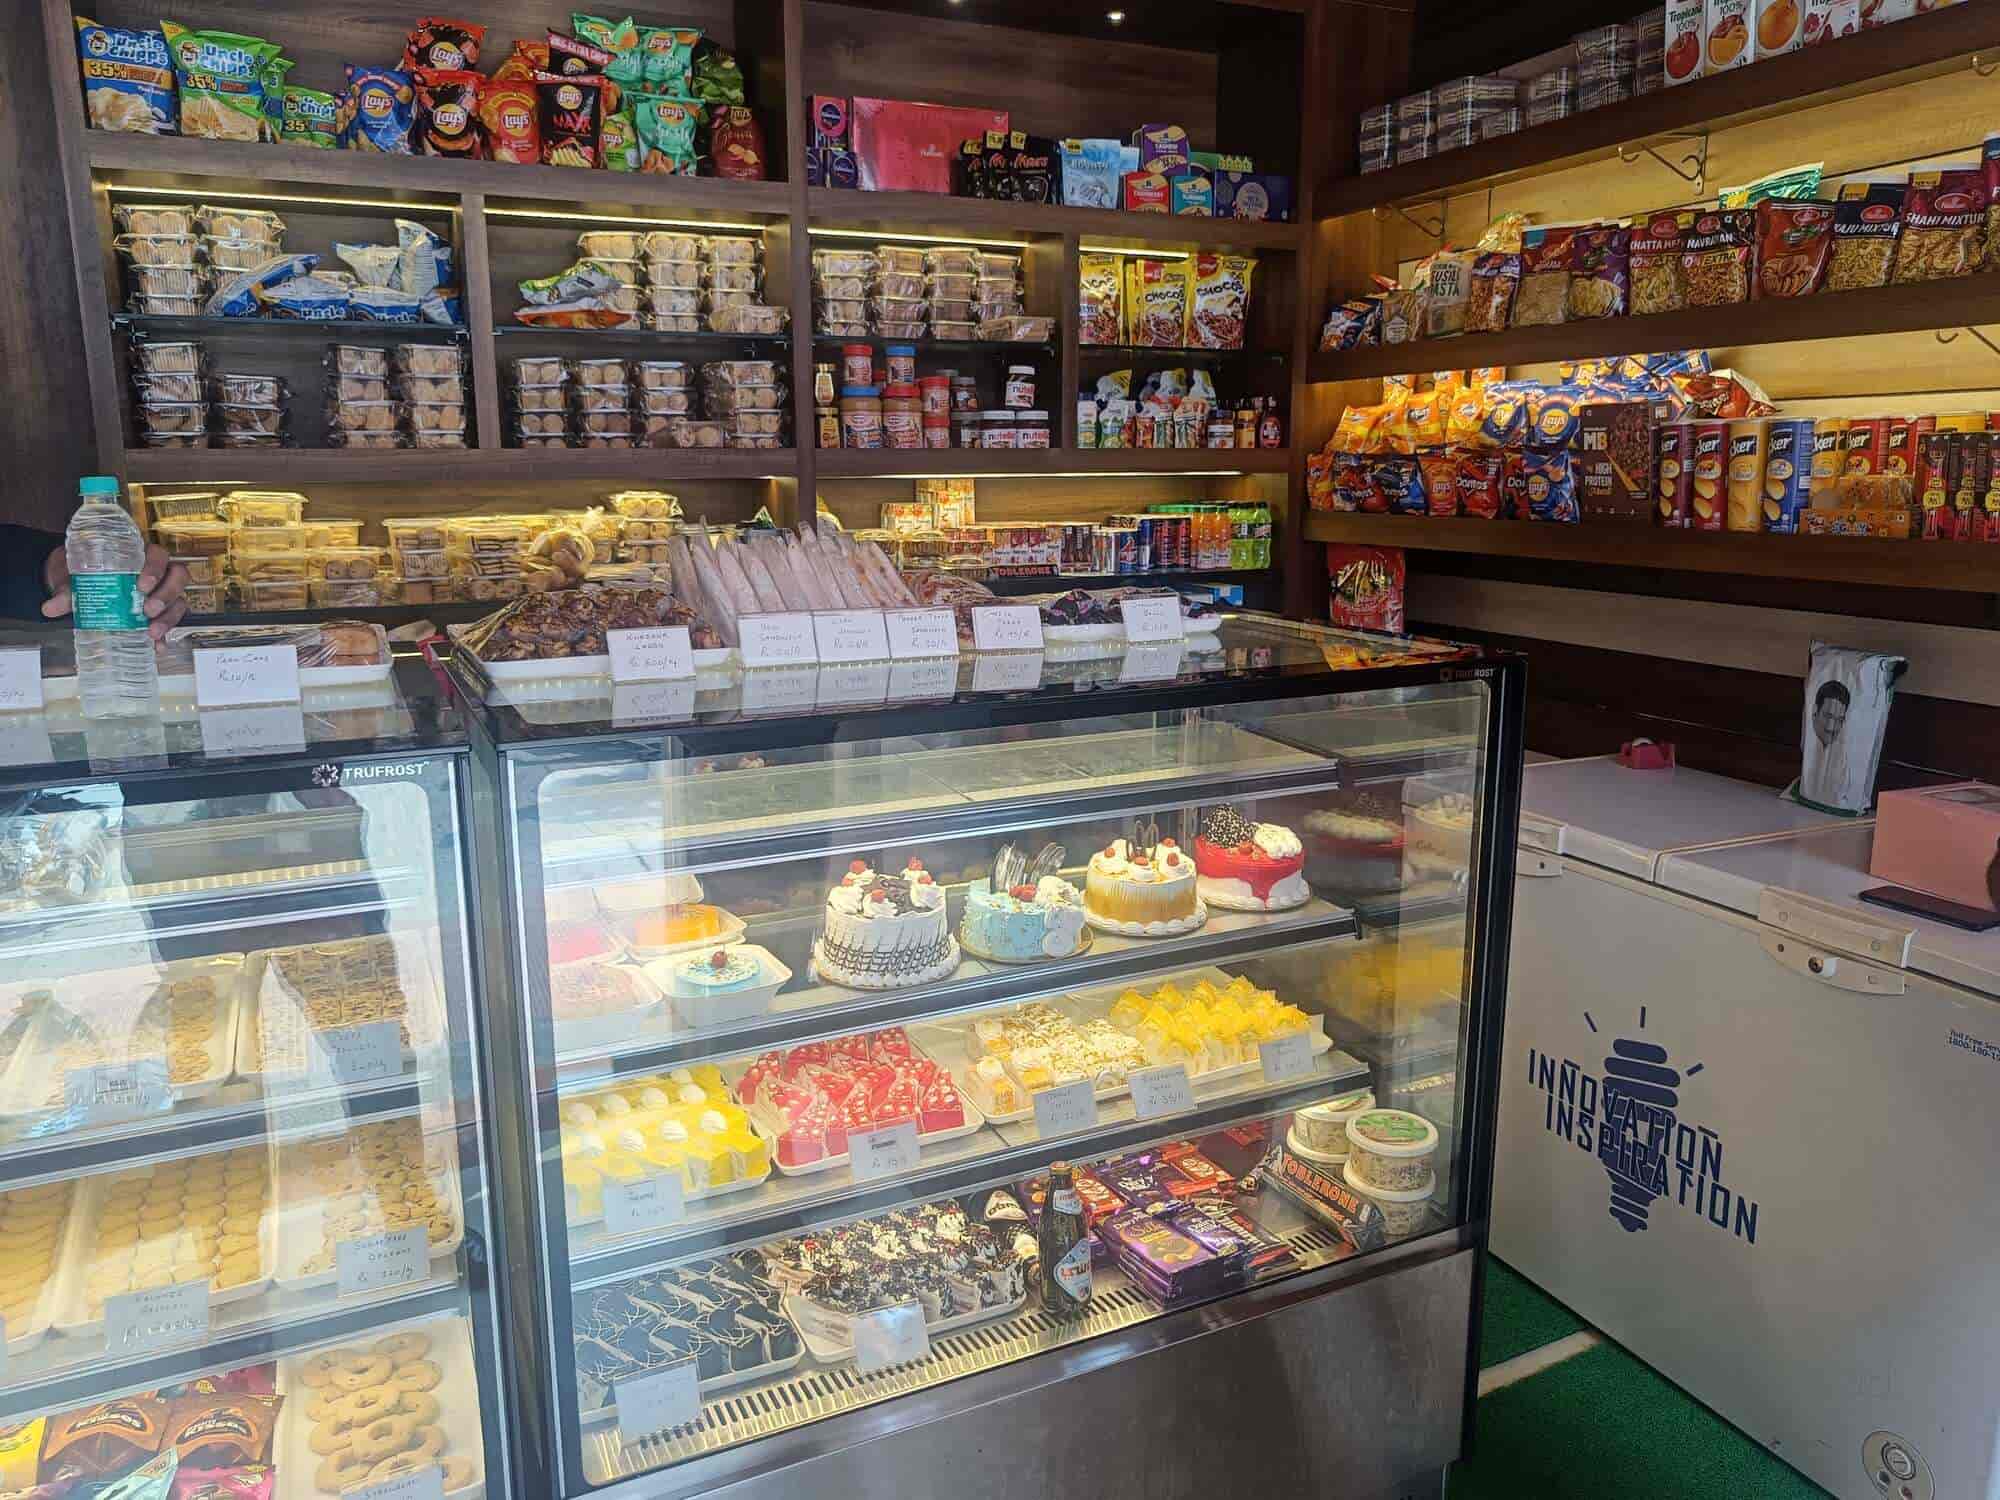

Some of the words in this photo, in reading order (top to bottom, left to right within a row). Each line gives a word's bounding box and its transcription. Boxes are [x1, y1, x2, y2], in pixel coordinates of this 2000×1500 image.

[1669, 5, 1704, 24] Tropicana
[89, 62, 128, 80] 35%
[362, 95, 393, 112] Lay's
[434, 109, 467, 127] Lay's
[1904, 212, 1944, 226] SHAHI
[1945, 212, 1985, 226] MIXTUR
[343, 763, 424, 780] TRUFROST
[1528, 1048, 1723, 1183] INNOVATION
[1546, 1093, 1758, 1245] INSPIRATION
[1283, 1153, 1360, 1213] TOBLERONE
